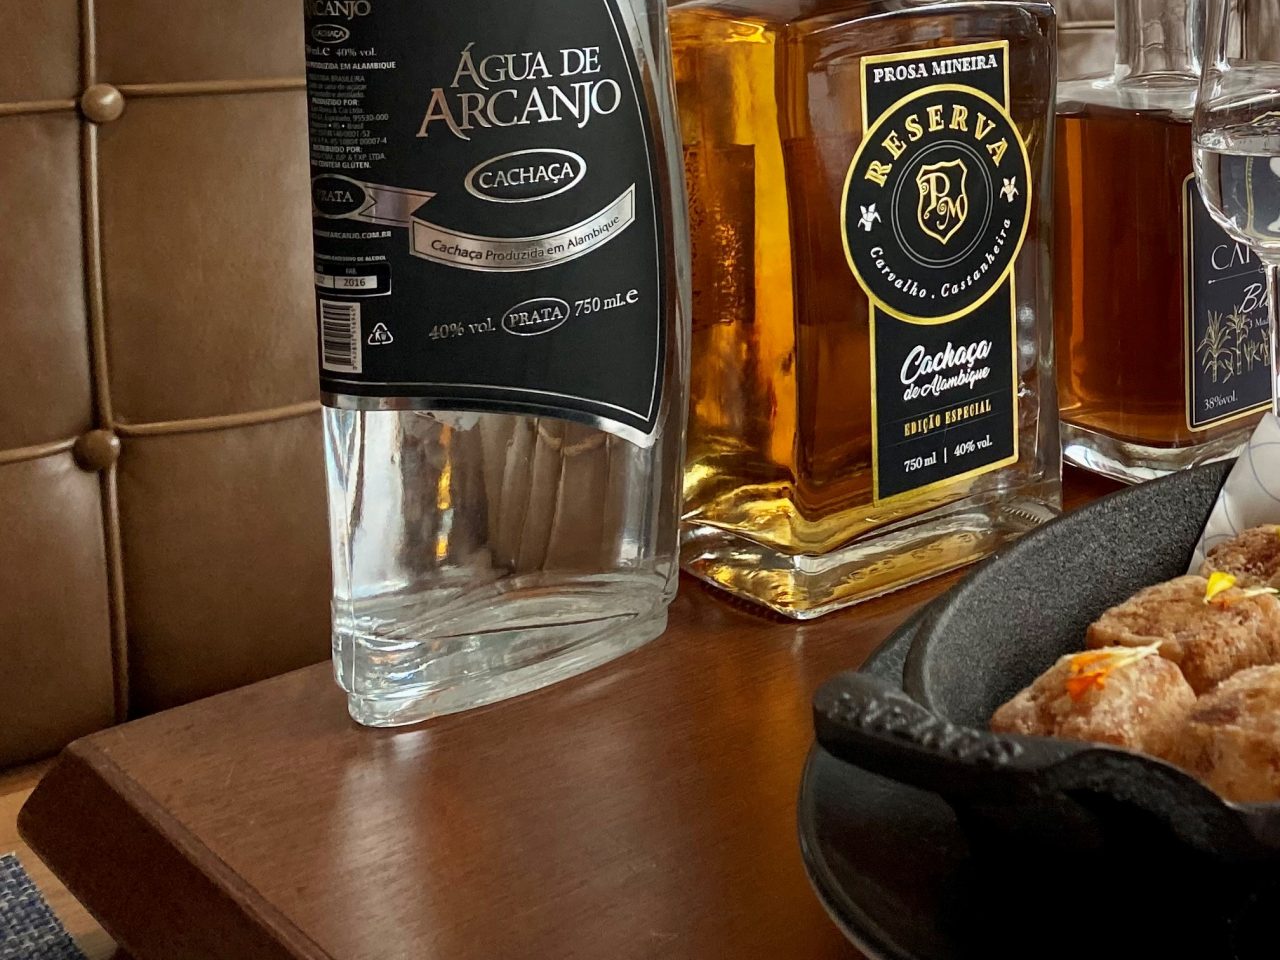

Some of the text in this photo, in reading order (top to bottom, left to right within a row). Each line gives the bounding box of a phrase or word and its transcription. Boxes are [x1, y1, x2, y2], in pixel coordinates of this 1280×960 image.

[352, 61, 397, 70] ALAMBIQUE
[450, 42, 601, 90] ÁGUA DE
[873, 54, 998, 84] PROSA MINEIRA
[415, 78, 622, 141] ARCANJO
[864, 103, 1009, 188] RESERVA
[478, 162, 575, 189] CACHAÇA
[431, 215, 620, 262] Cachaça Produzida em Alambique
[869, 218, 1011, 299] Carvalho Castanheira
[343, 278, 366, 288] 2016
[429, 321, 465, 340] 40%
[508, 305, 564, 328] PRATA
[574, 296, 601, 318] 750
[900, 339, 993, 385] Cachaça
[903, 366, 991, 401] de Alambique
[903, 398, 992, 437] EDIÇÃO ESPECIAL
[903, 434, 993, 473] 750 ml 40% vol.
